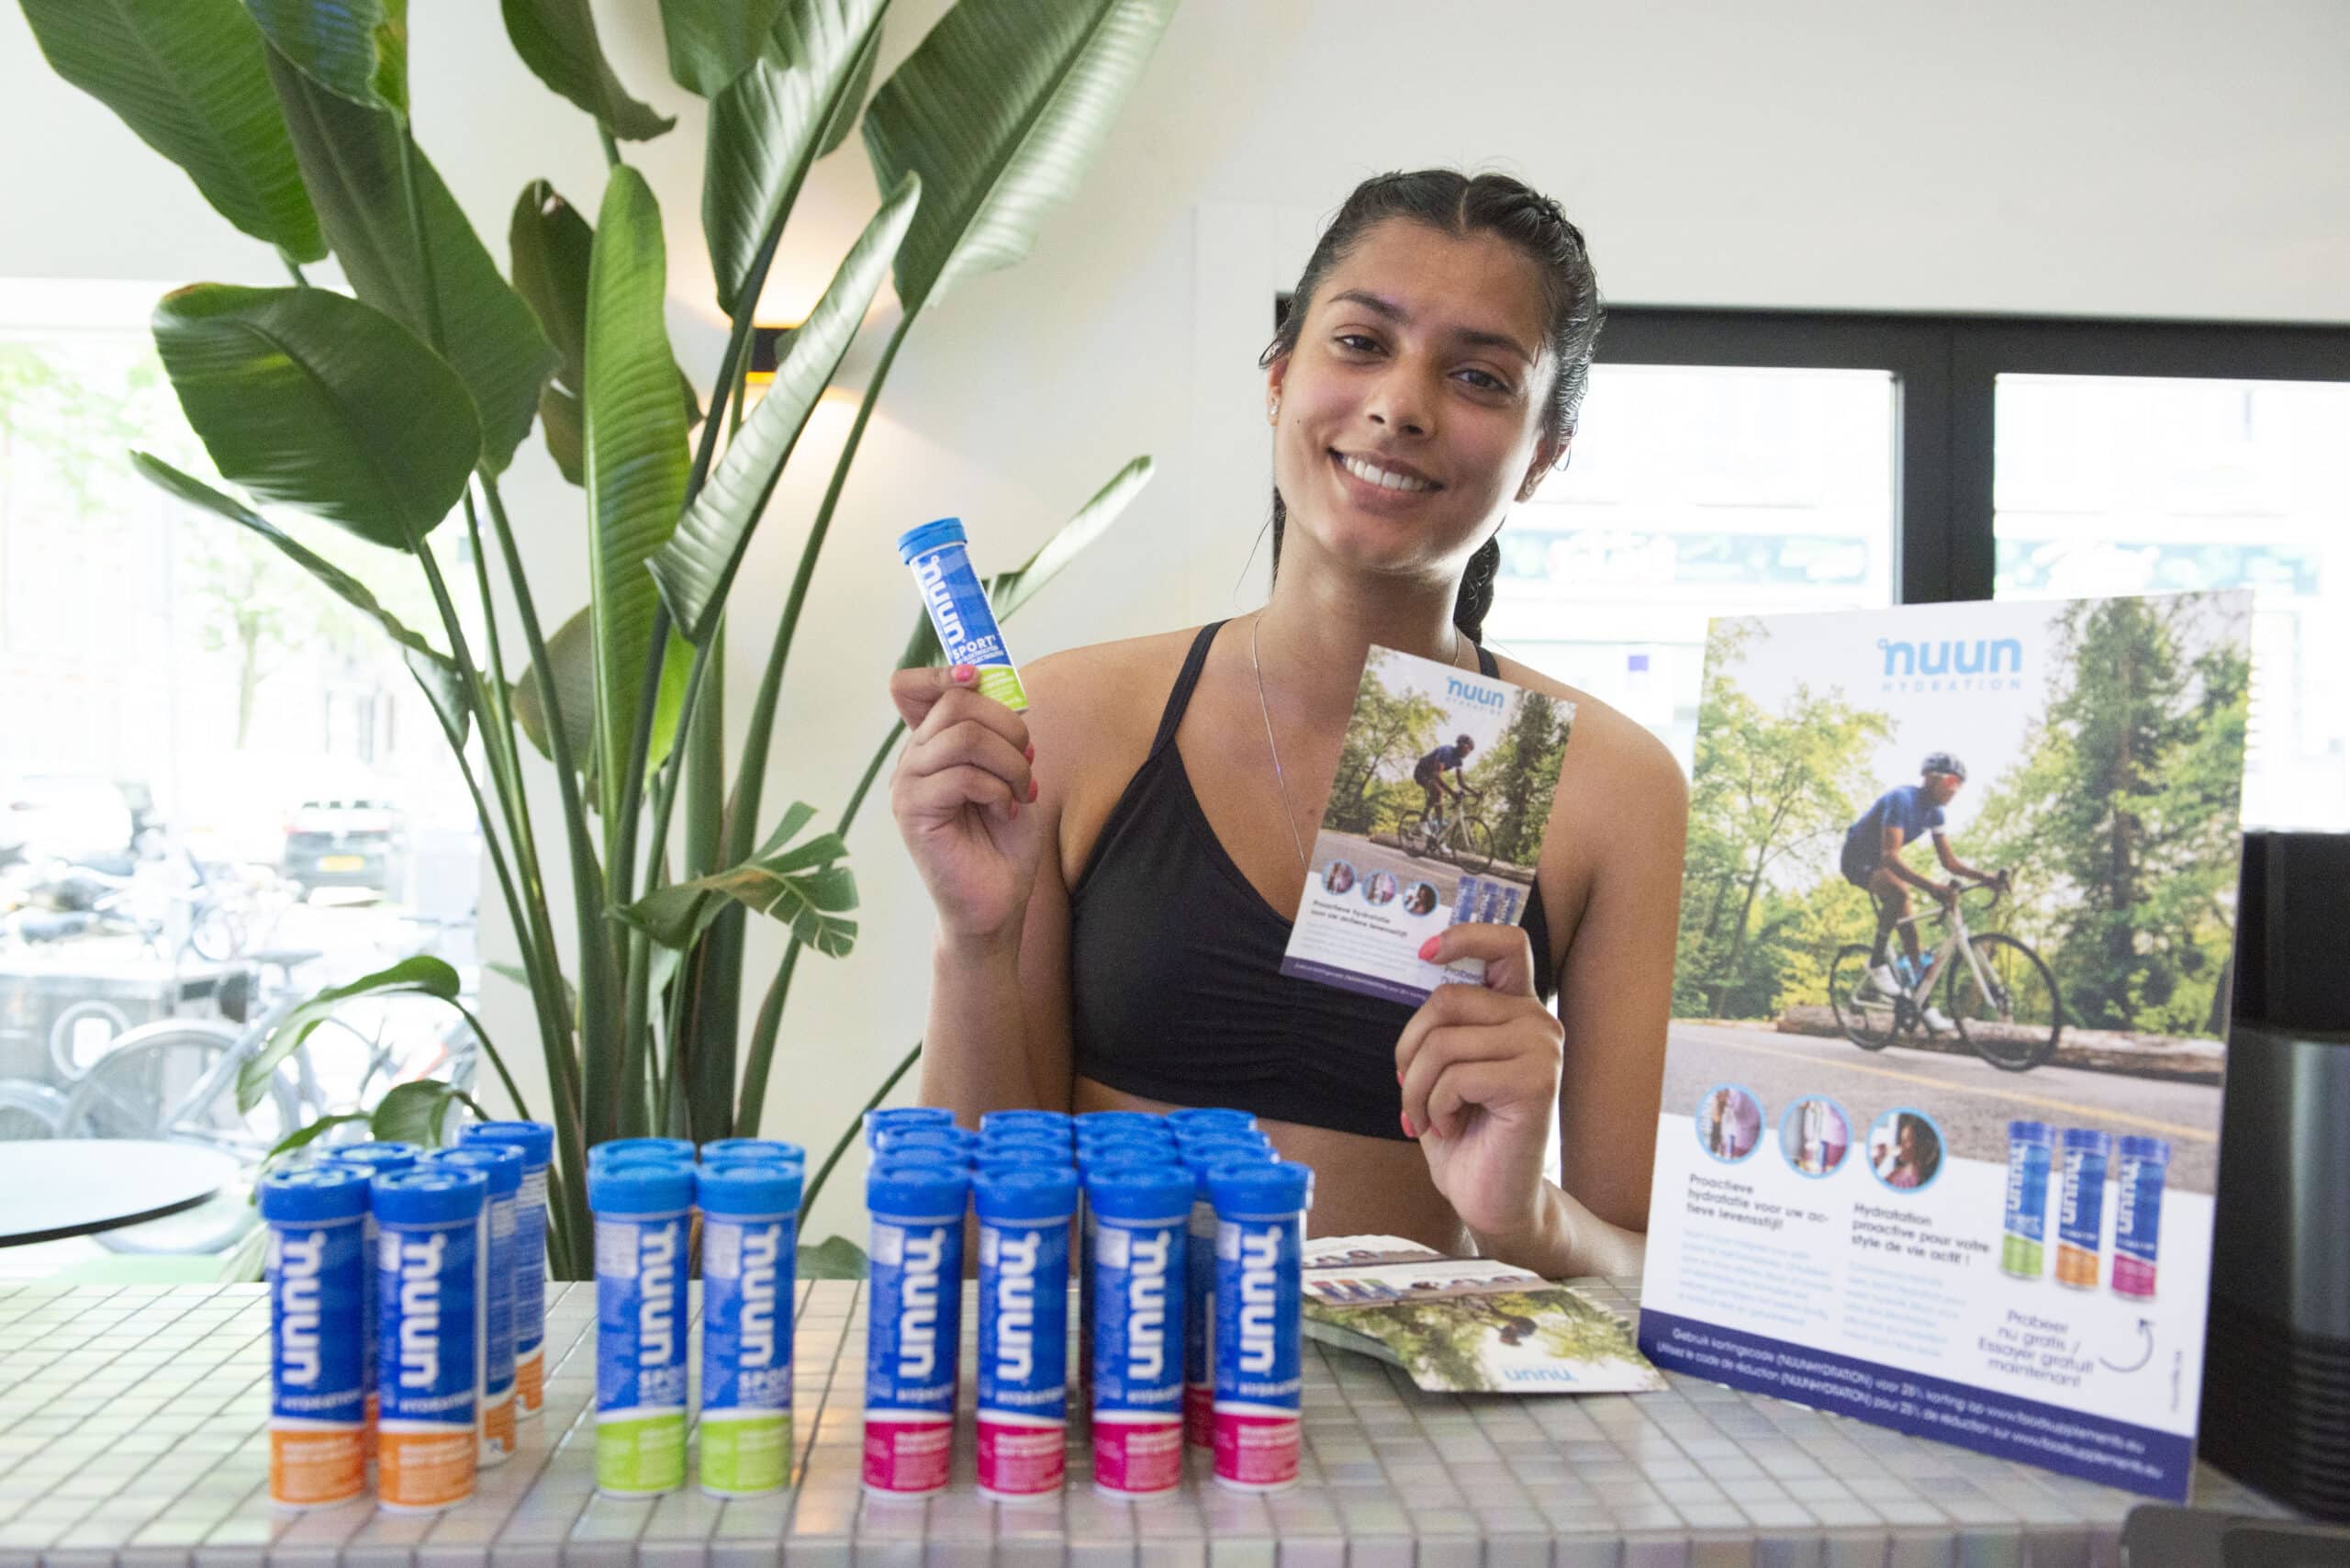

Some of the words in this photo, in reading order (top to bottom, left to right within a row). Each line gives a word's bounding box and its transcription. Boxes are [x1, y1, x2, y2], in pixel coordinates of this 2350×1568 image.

[920, 554, 966, 646] nuun
[953, 634, 995, 659] SPORT
[1878, 638, 2022, 676] nuun
[1448, 677, 1505, 709] nuun
[1881, 678, 2022, 693] HYDRATION
[1689, 1173, 1753, 1193] Proactieve
[2062, 1153, 2084, 1225] nuun
[2118, 1160, 2142, 1235] nuun
[1686, 1202, 1715, 1216] tieve
[1754, 1201, 1782, 1215] voor
[1785, 1207, 1803, 1219] uw
[1853, 1202, 1931, 1226] Hydratation
[1852, 1220, 1915, 1238] proactive
[1919, 1232, 1952, 1247] pour
[1955, 1238, 1990, 1253] votre
[1852, 1235, 1880, 1249] style
[1885, 1241, 1902, 1252] de
[1907, 1245, 1926, 1257] vie
[281, 1230, 326, 1386] nuun
[399, 1233, 446, 1388] nuun
[639, 1220, 678, 1369] nuun
[739, 1223, 780, 1367] nuun
[898, 1227, 946, 1379] nuun
[996, 1230, 1041, 1380] nuun
[1127, 1229, 1171, 1380] nuun
[1239, 1226, 1282, 1373] nuun
[1998, 1327, 2018, 1340] nu
[2023, 1333, 2066, 1351] gratis
[2008, 1309, 2068, 1333] Probeer
[1978, 1337, 2035, 1361] Essayer
[1672, 1327, 1709, 1346] Gebruik
[1711, 1338, 1774, 1362] kortingscode
[1874, 1378, 1900, 1393] voor
[1925, 1390, 1966, 1412] korting
[1967, 1400, 1986, 1416] op
[1988, 1359, 2081, 1388] maintenant
[1686, 1350, 1695, 1360] le
[1695, 1352, 1719, 1367] code
[1720, 1358, 1734, 1370] de
[1873, 1396, 1898, 1412] pour
[1923, 1408, 1940, 1422] de
[1993, 1427, 2010, 1440] sur
